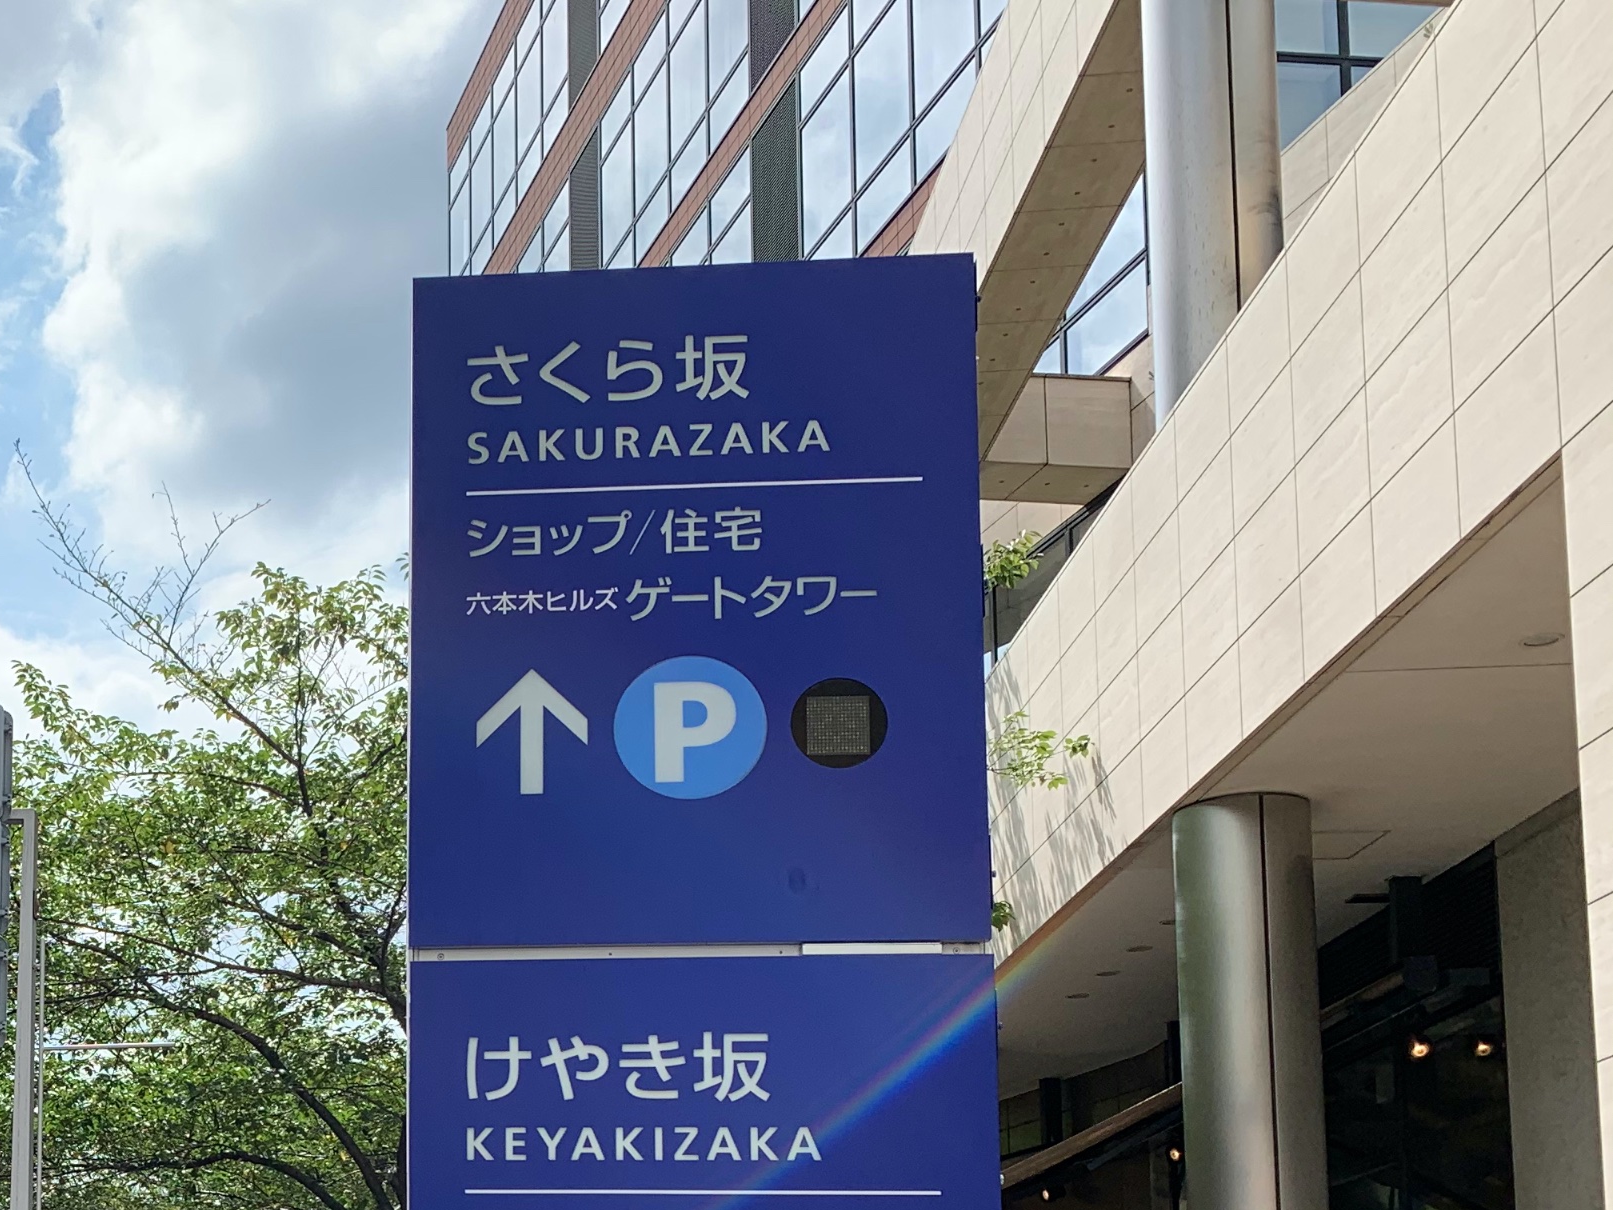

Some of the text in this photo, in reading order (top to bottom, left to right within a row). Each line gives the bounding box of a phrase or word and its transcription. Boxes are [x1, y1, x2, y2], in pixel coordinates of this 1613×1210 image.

[467, 335, 750, 405] さくら坂
[468, 419, 831, 464] SAKURAZAKA
[467, 506, 763, 558] ショップ/住宅
[653, 681, 737, 783] P
[466, 1031, 771, 1102] けやき坂
[466, 1126, 822, 1161] KEYAKIZAKA
